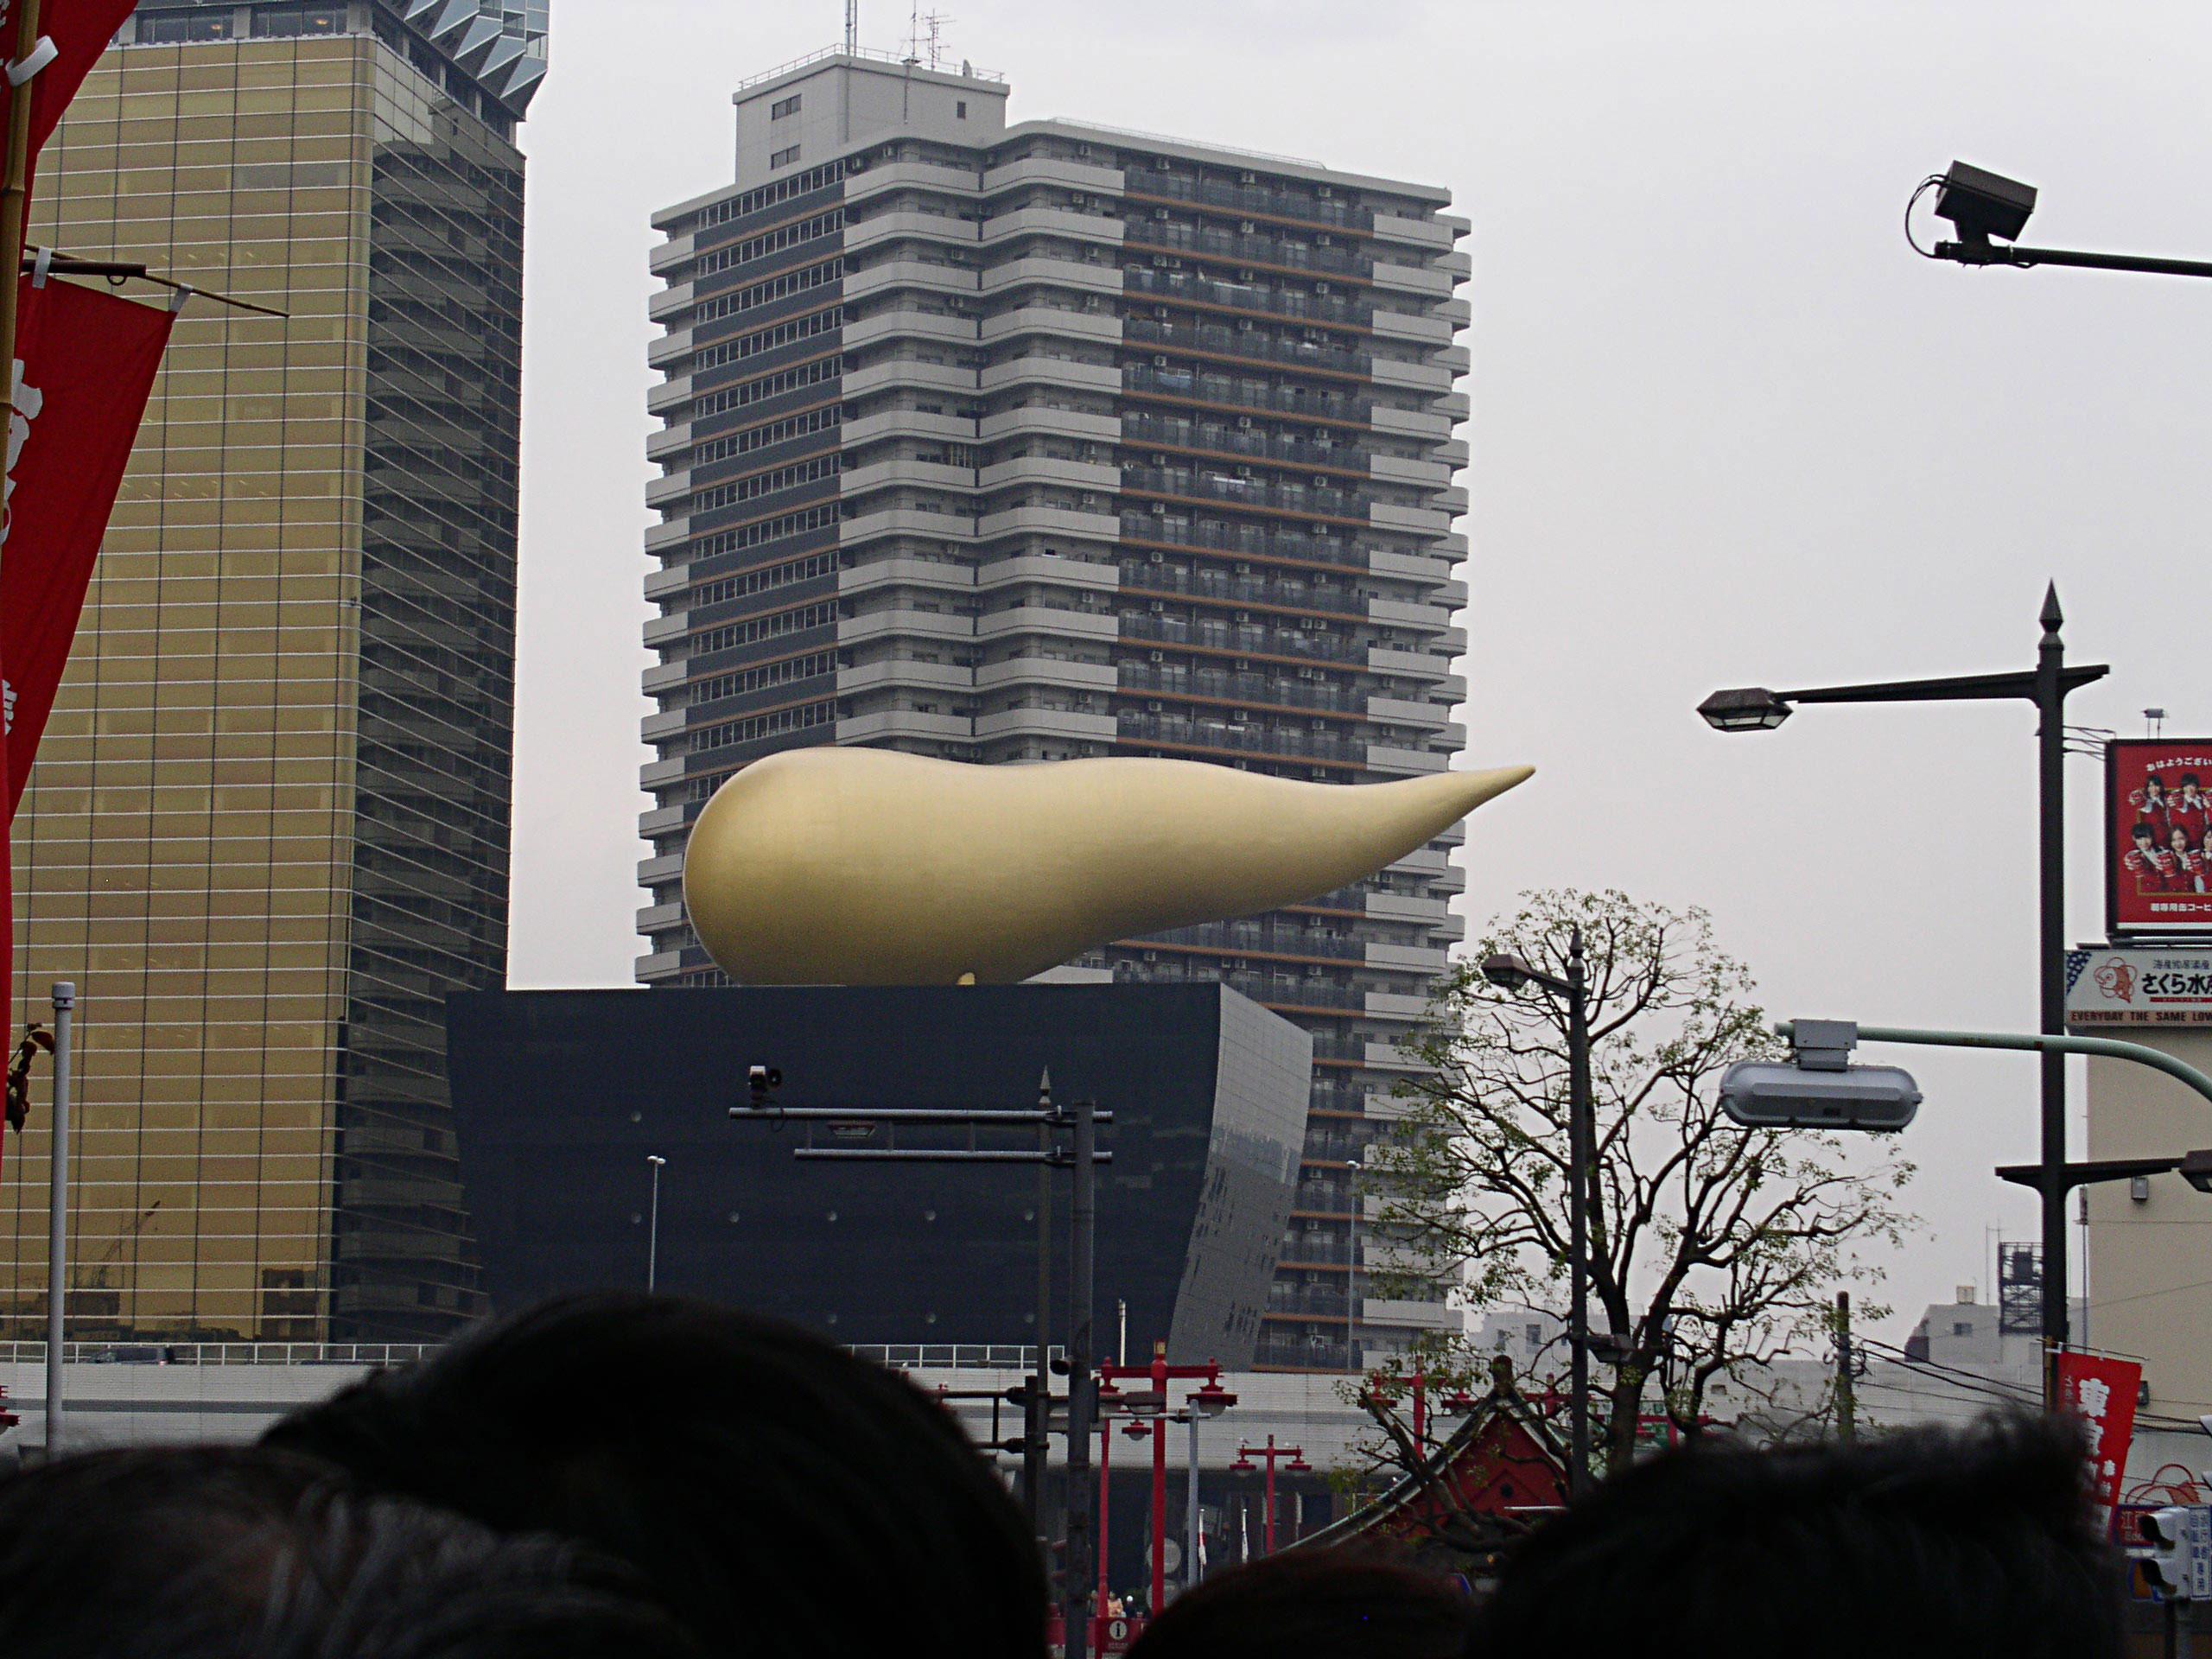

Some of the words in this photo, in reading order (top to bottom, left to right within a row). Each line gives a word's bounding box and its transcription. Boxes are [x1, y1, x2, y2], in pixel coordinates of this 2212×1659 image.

[2071, 1011, 2124, 1021] EVERYDAY
[2130, 1011, 2149, 1021] THE
[2156, 1011, 2186, 1021] SAME
